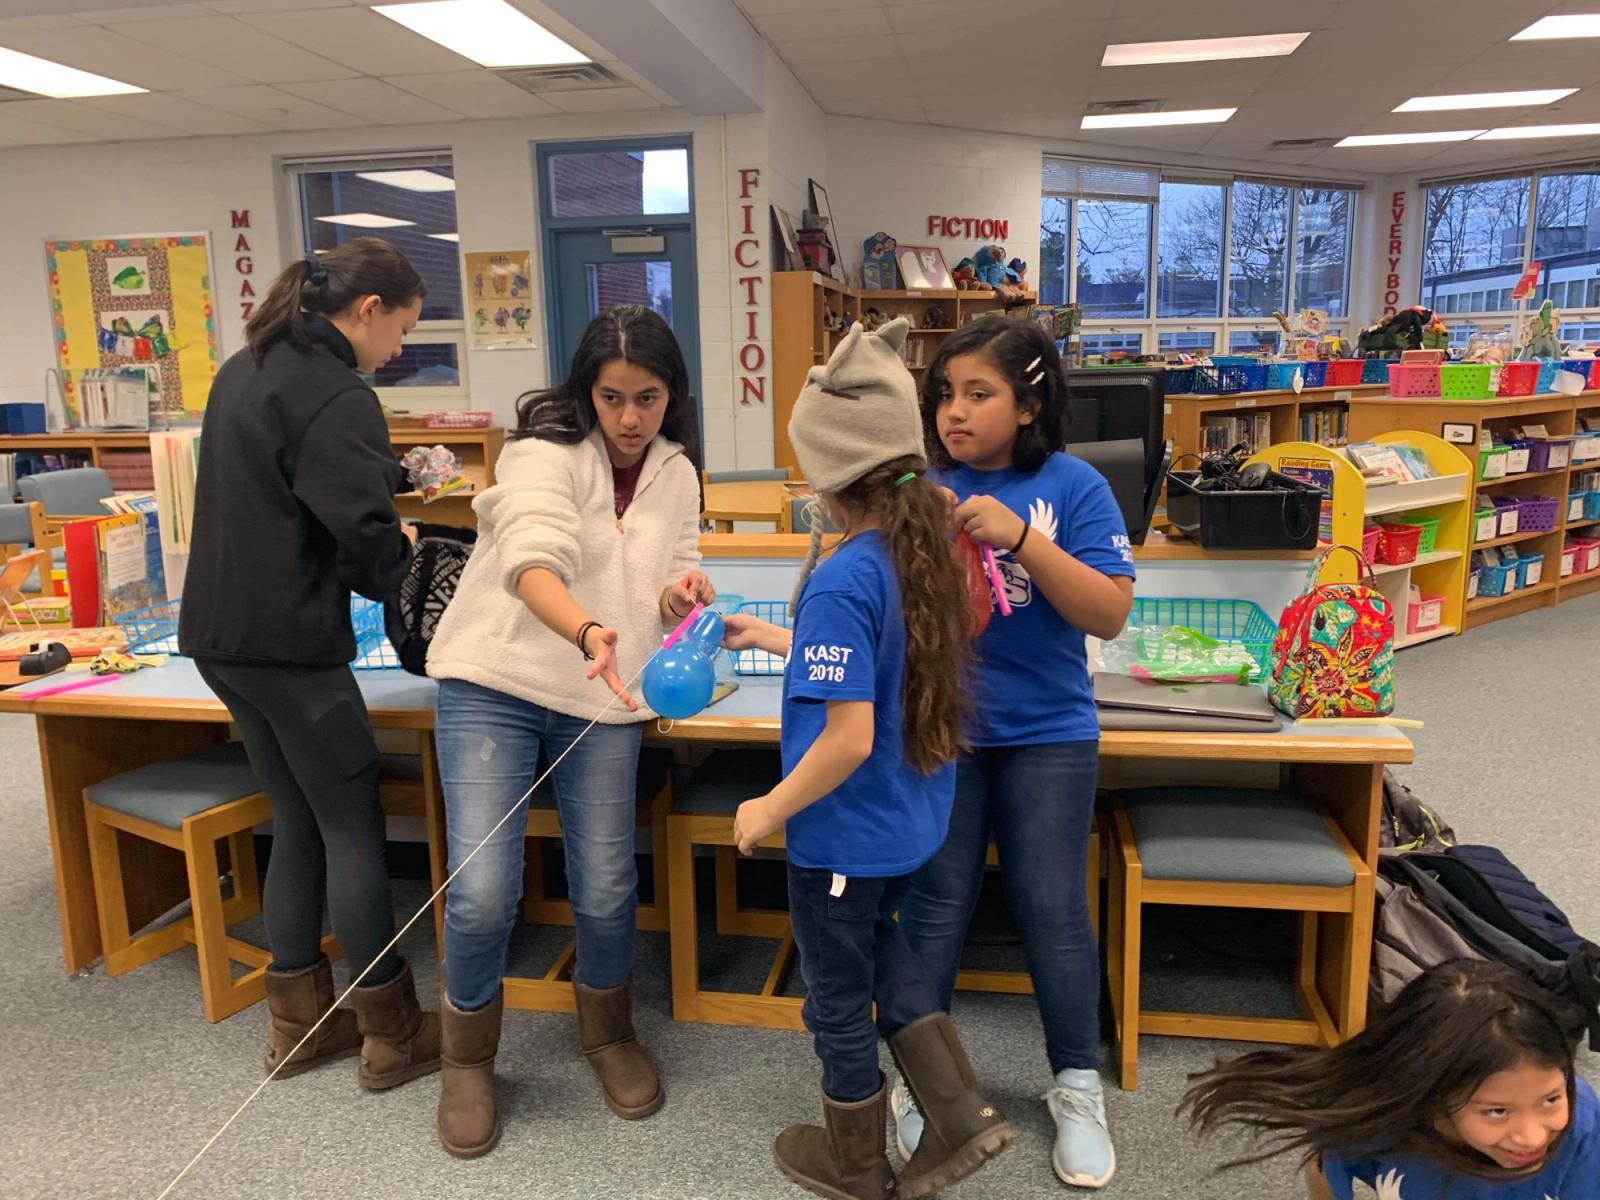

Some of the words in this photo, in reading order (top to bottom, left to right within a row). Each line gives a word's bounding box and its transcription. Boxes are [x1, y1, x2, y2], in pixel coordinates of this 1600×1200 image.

[928, 215, 1009, 240] FICTION
[230, 209, 256, 321] MAGAZ
[735, 168, 766, 404] FICTION
[1281, 458, 1309, 469] Reading
[804, 645, 853, 664] KAST
[808, 664, 845, 682] 2018
